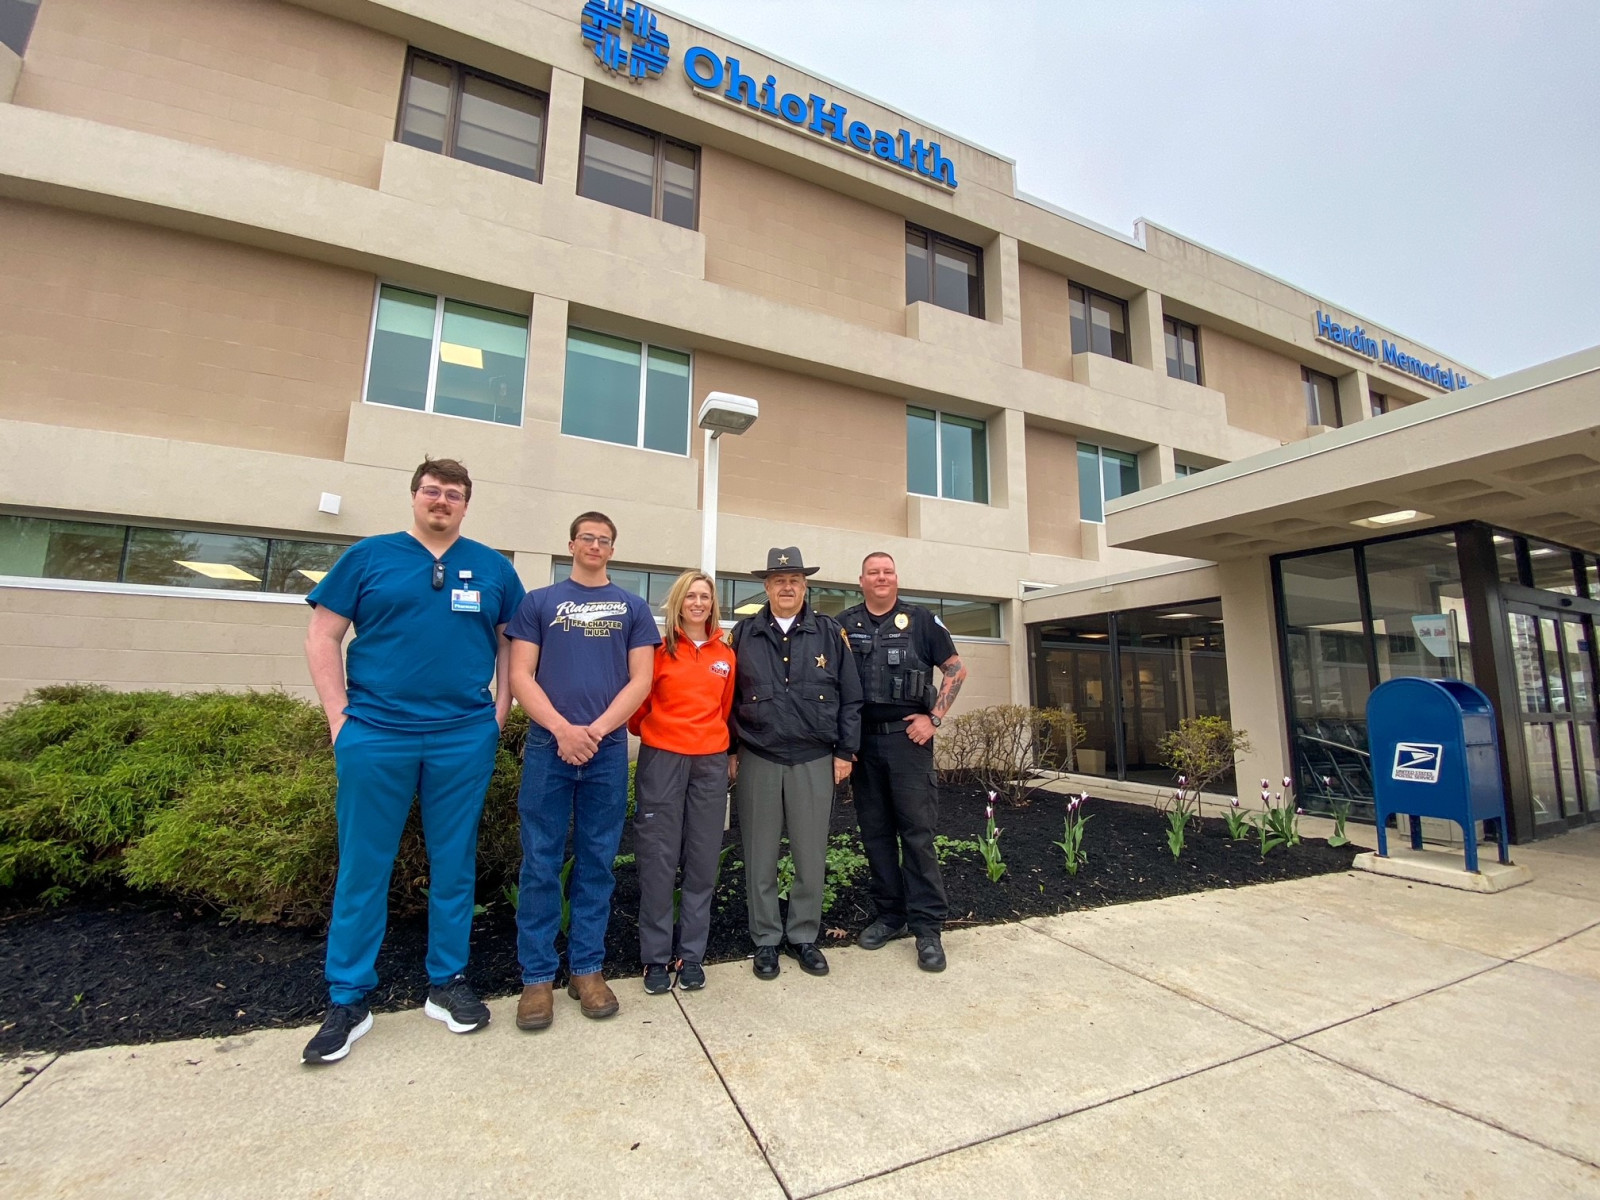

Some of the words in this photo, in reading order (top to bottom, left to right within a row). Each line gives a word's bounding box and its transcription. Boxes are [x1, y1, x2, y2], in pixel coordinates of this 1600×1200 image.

[683, 45, 958, 188] OhioHealth
[1316, 310, 1379, 359] Hardin
[1382, 339, 1455, 391] Memorial
[556, 601, 627, 616] Ridgemont
[571, 619, 586, 627] FFA
[587, 620, 622, 629] CHAPTER
[584, 628, 593, 637] IN
[594, 628, 610, 637] USA
